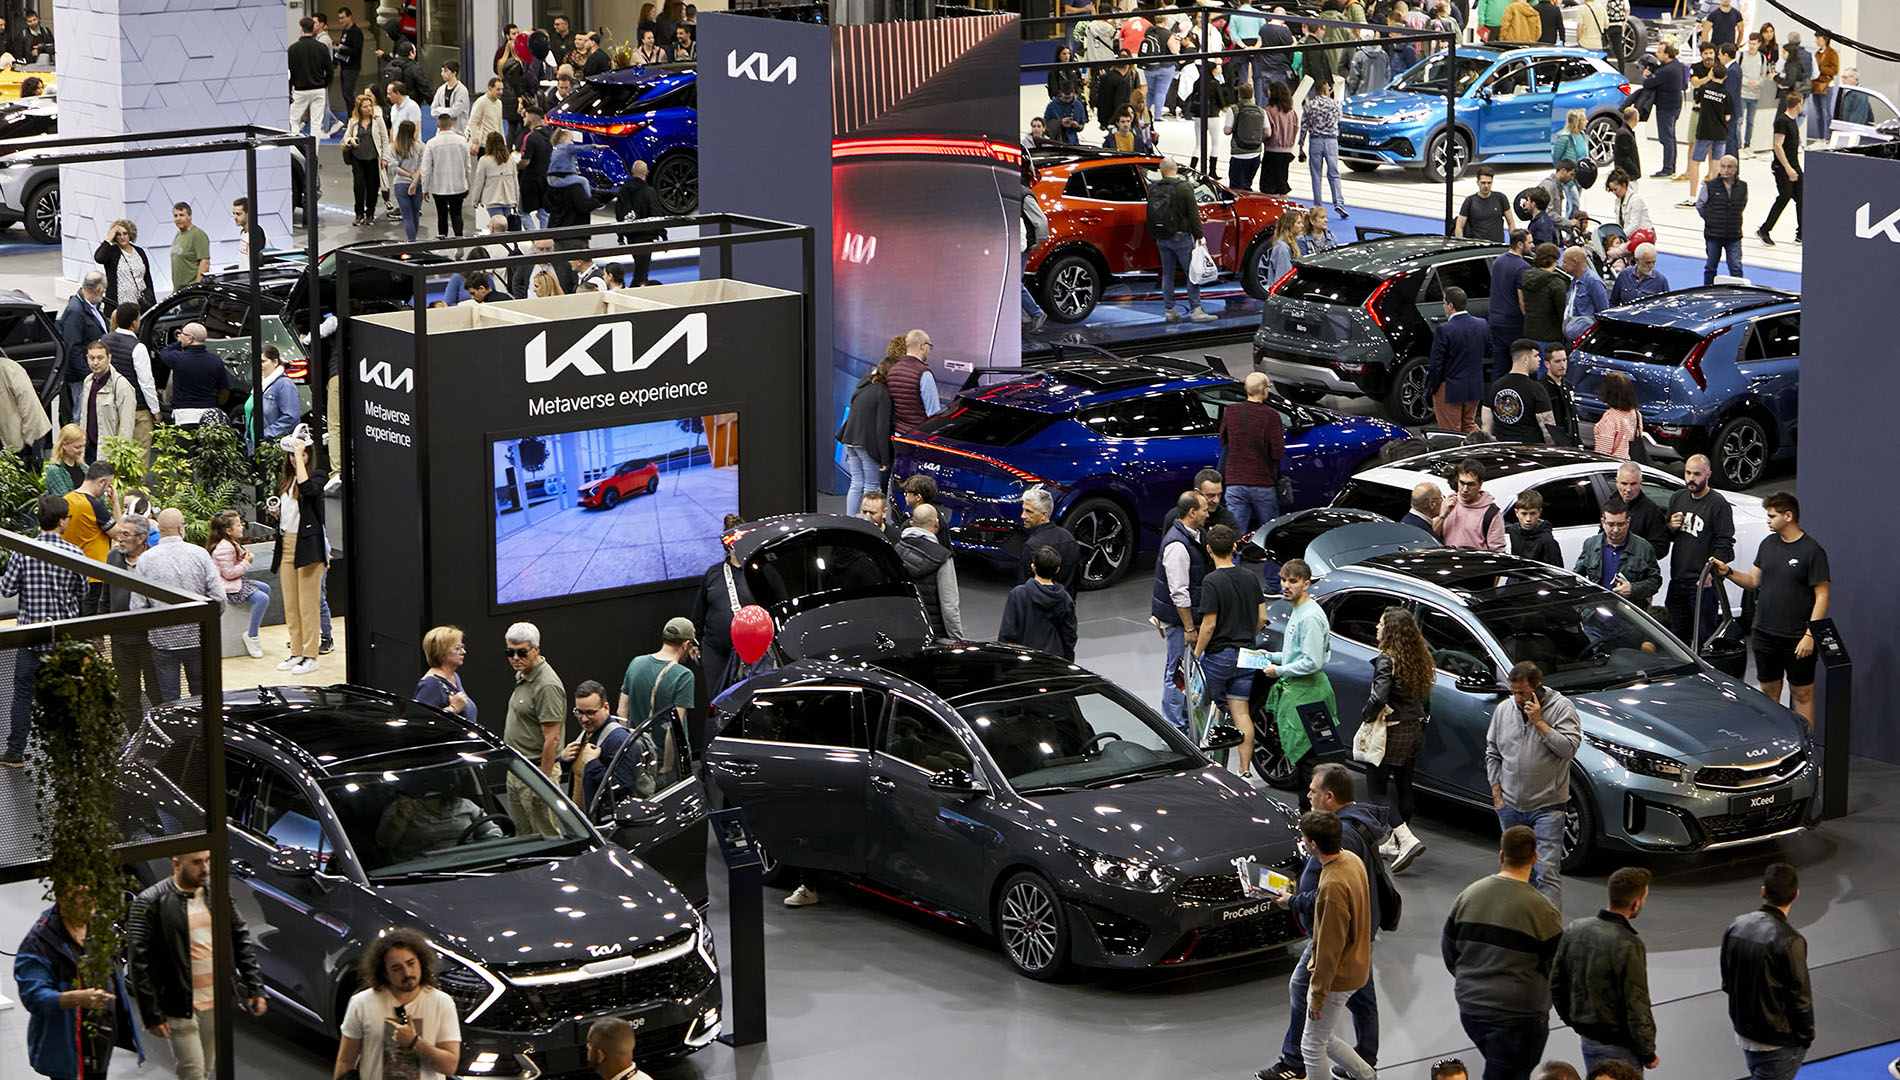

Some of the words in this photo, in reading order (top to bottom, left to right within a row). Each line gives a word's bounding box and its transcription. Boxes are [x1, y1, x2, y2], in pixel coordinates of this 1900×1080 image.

[727, 48, 797, 85] KIA
[525, 312, 708, 383] KIA
[359, 356, 414, 394] KIA
[528, 394, 615, 417] Metaverse
[619, 380, 709, 406] experience
[364, 400, 411, 426] Metaverse
[365, 423, 412, 448] experience
[1681, 512, 1704, 537] AP
[1750, 795, 1775, 807] XCeed
[1223, 904, 1259, 920] ProCeed
[1260, 901, 1272, 912] GT
